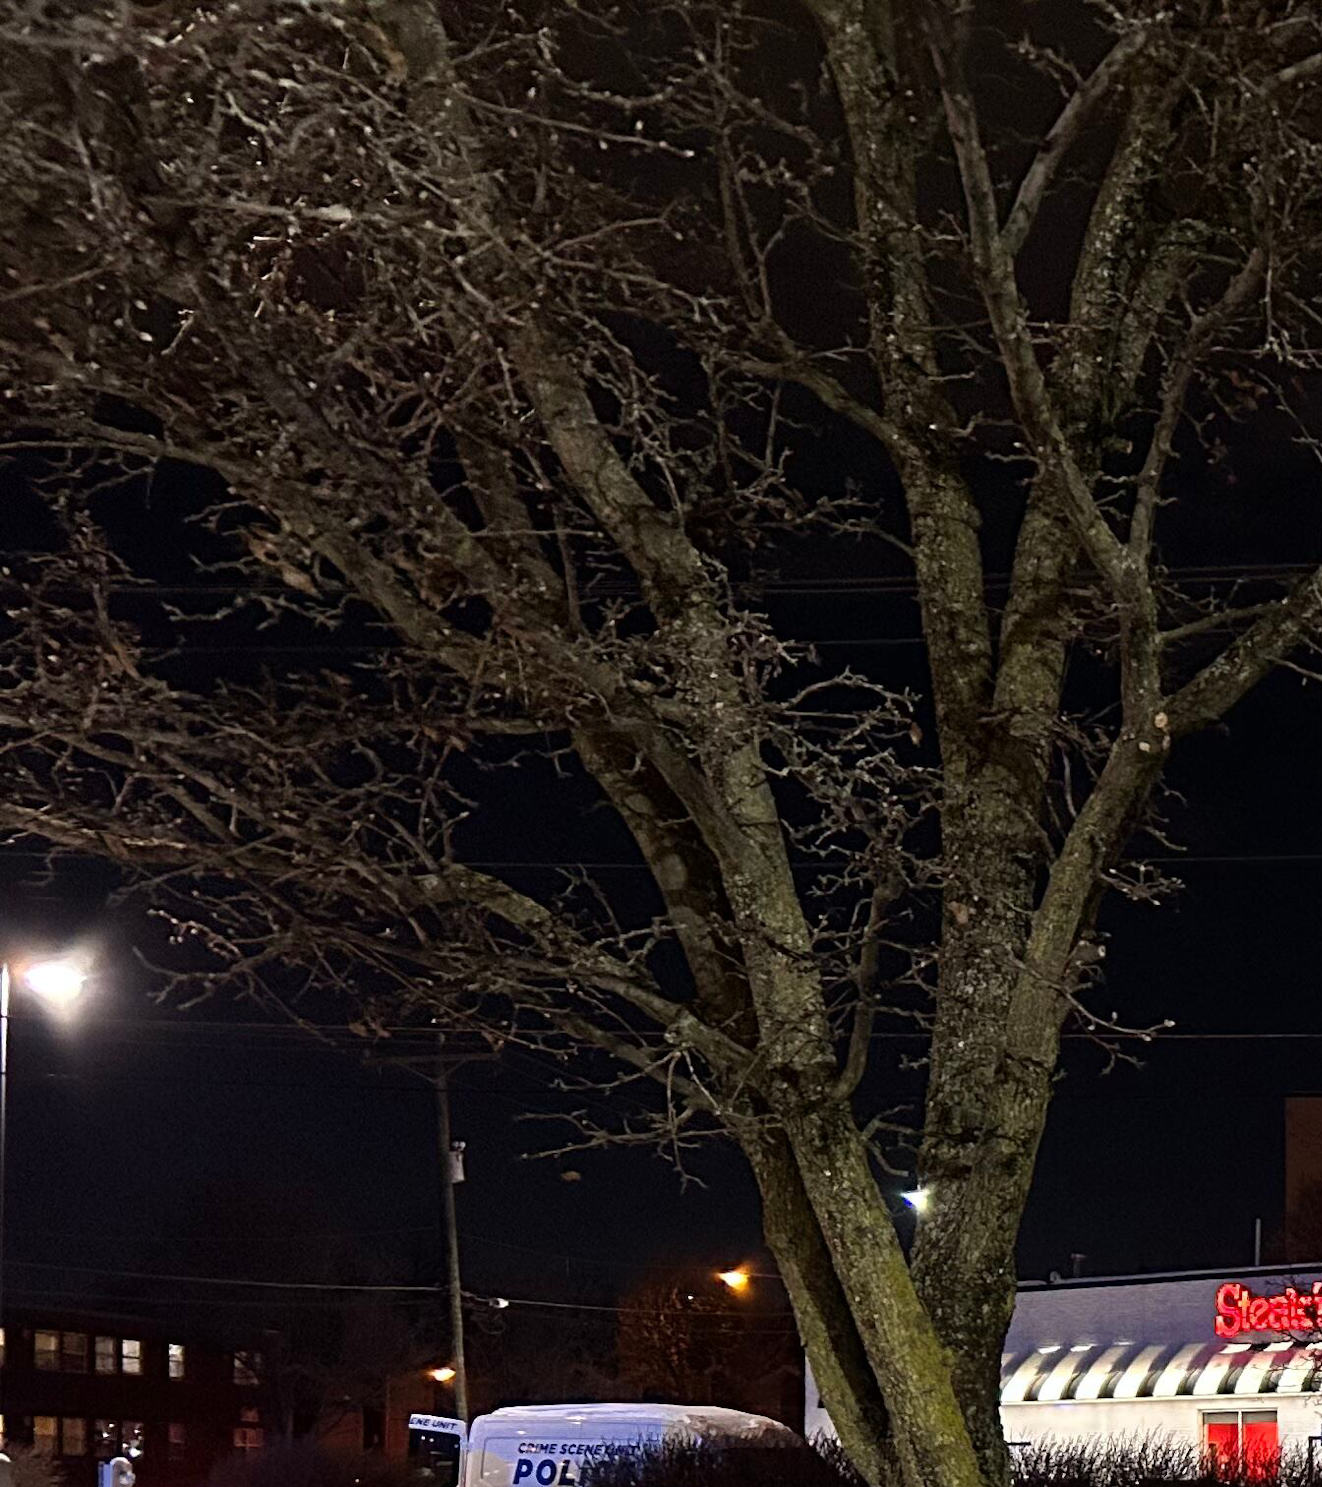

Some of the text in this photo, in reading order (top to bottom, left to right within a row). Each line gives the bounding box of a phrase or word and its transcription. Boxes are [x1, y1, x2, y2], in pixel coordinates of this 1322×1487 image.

[518, 1442, 557, 1455] CRIME
[559, 1443, 604, 1455] SCENE
[512, 1457, 575, 1486] POL
